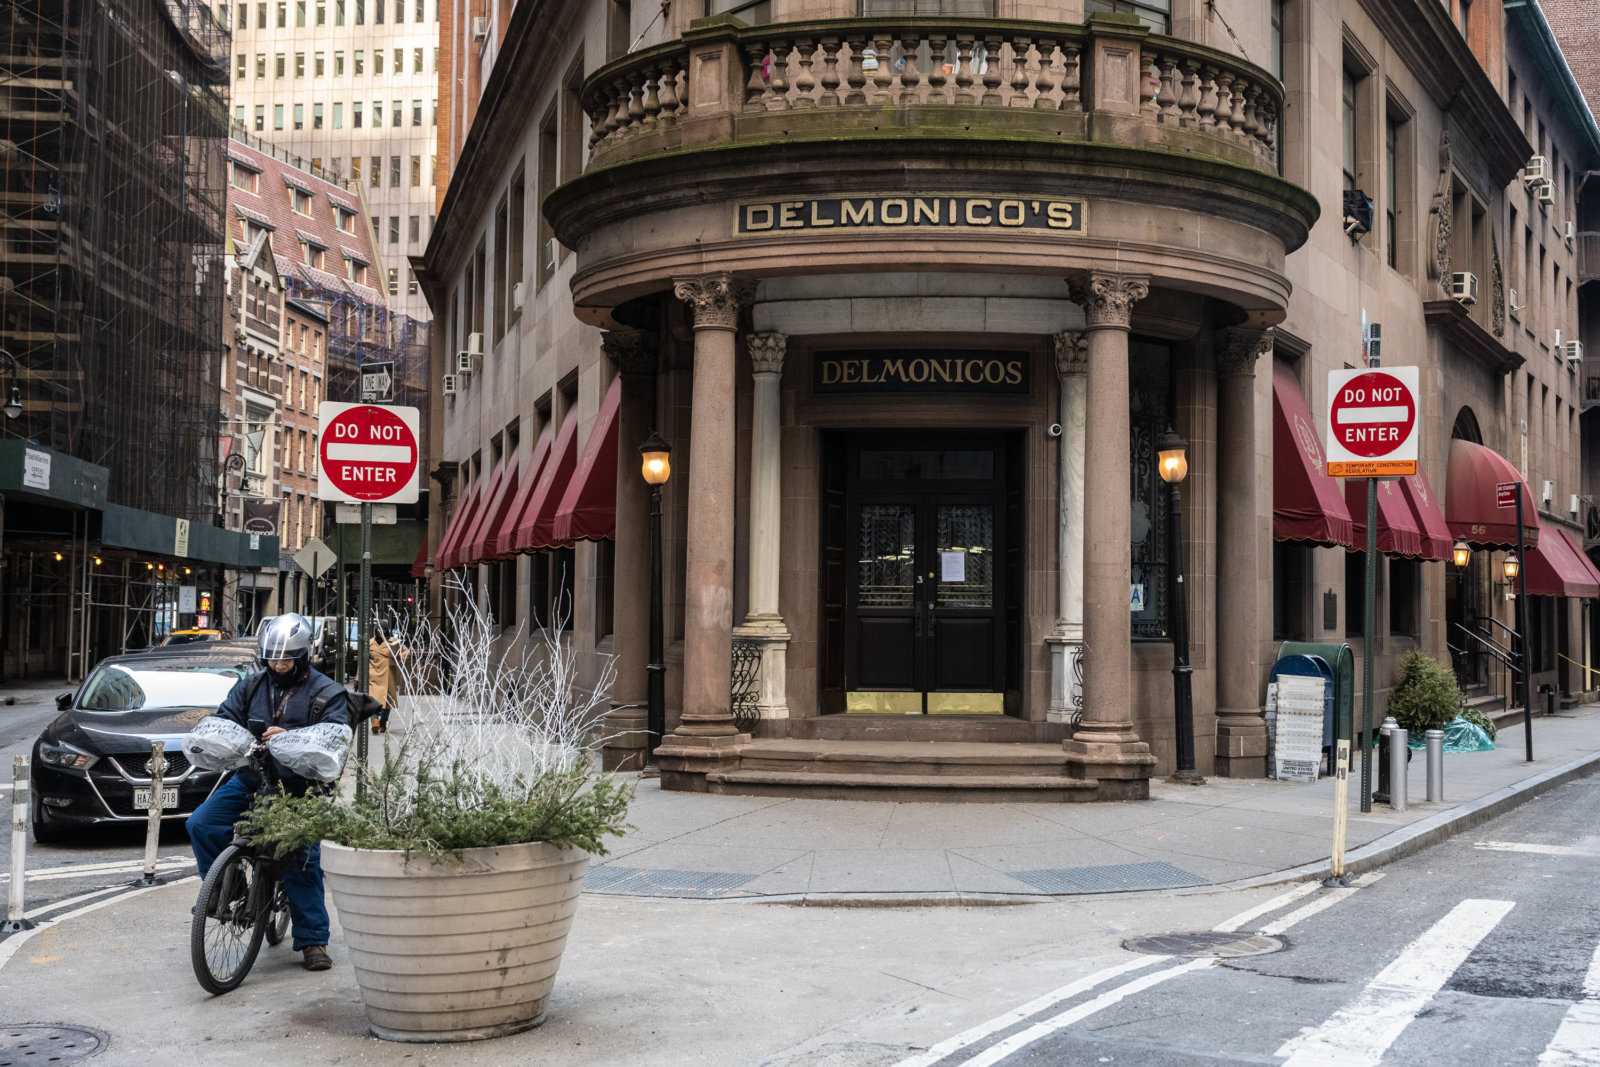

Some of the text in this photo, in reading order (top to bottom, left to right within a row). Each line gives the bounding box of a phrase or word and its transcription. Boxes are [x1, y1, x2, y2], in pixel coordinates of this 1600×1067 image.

[746, 198, 1073, 230] DELMONICO'S
[820, 358, 1022, 385] DELMONICOS
[365, 375, 388, 390] ONE WAY
[1344, 387, 1402, 403] DO NOT
[335, 423, 403, 441] DO NOT
[1345, 427, 1399, 442] ENTER
[342, 466, 396, 483] ENTER
[1471, 525, 1486, 535] 56
[1130, 588, 1140, 604] A
